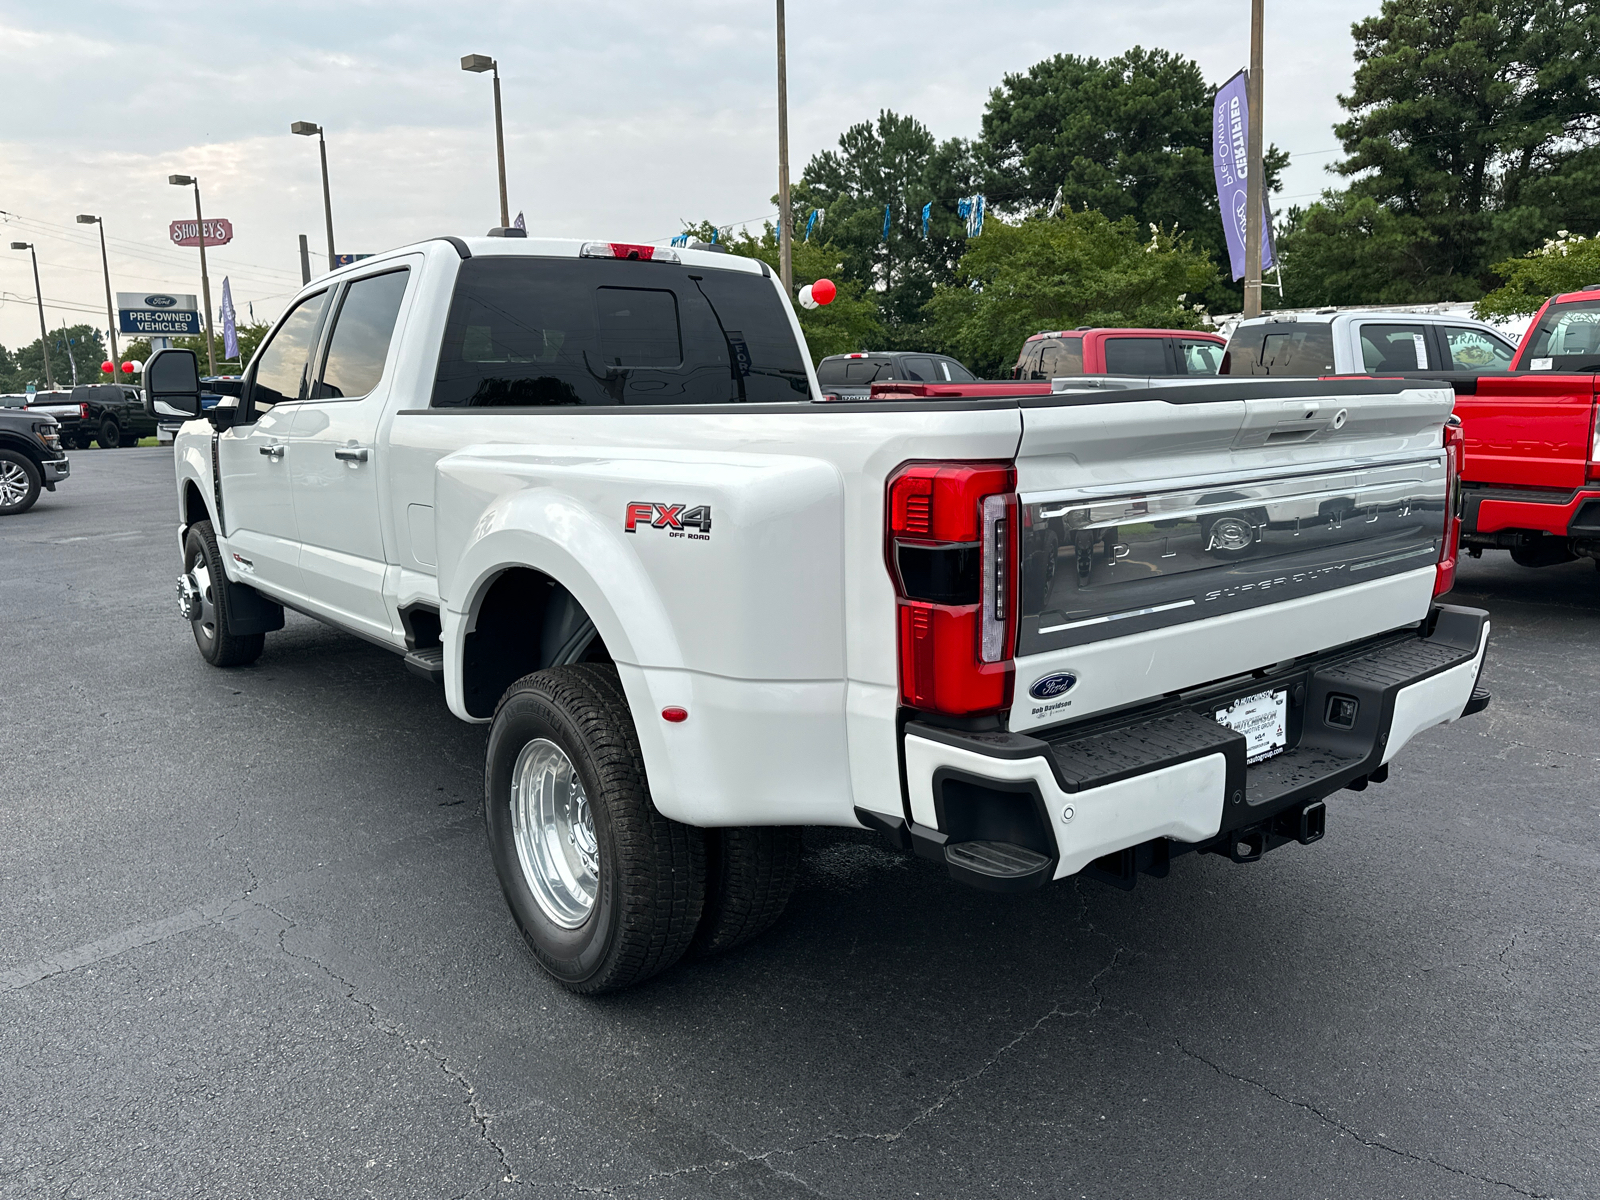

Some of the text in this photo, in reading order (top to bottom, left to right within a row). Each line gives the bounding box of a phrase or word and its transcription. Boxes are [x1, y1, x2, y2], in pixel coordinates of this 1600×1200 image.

[129, 312, 192, 322] PRE-OWNED
[136, 322, 188, 331] VEHICLES
[1464, 438, 1568, 452] DUTY
[625, 501, 712, 534] FX4
[688, 533, 710, 541] ROAD
[1108, 498, 1412, 566] PLATINUM
[1205, 563, 1346, 602] SUPER DUTY
[1042, 677, 1069, 695] Ford
[517, 699, 562, 734] MICHELIN
[1031, 706, 1044, 715] Bob
[1044, 700, 1072, 712] Davidson
[1247, 747, 1284, 765] nautogroup.com
